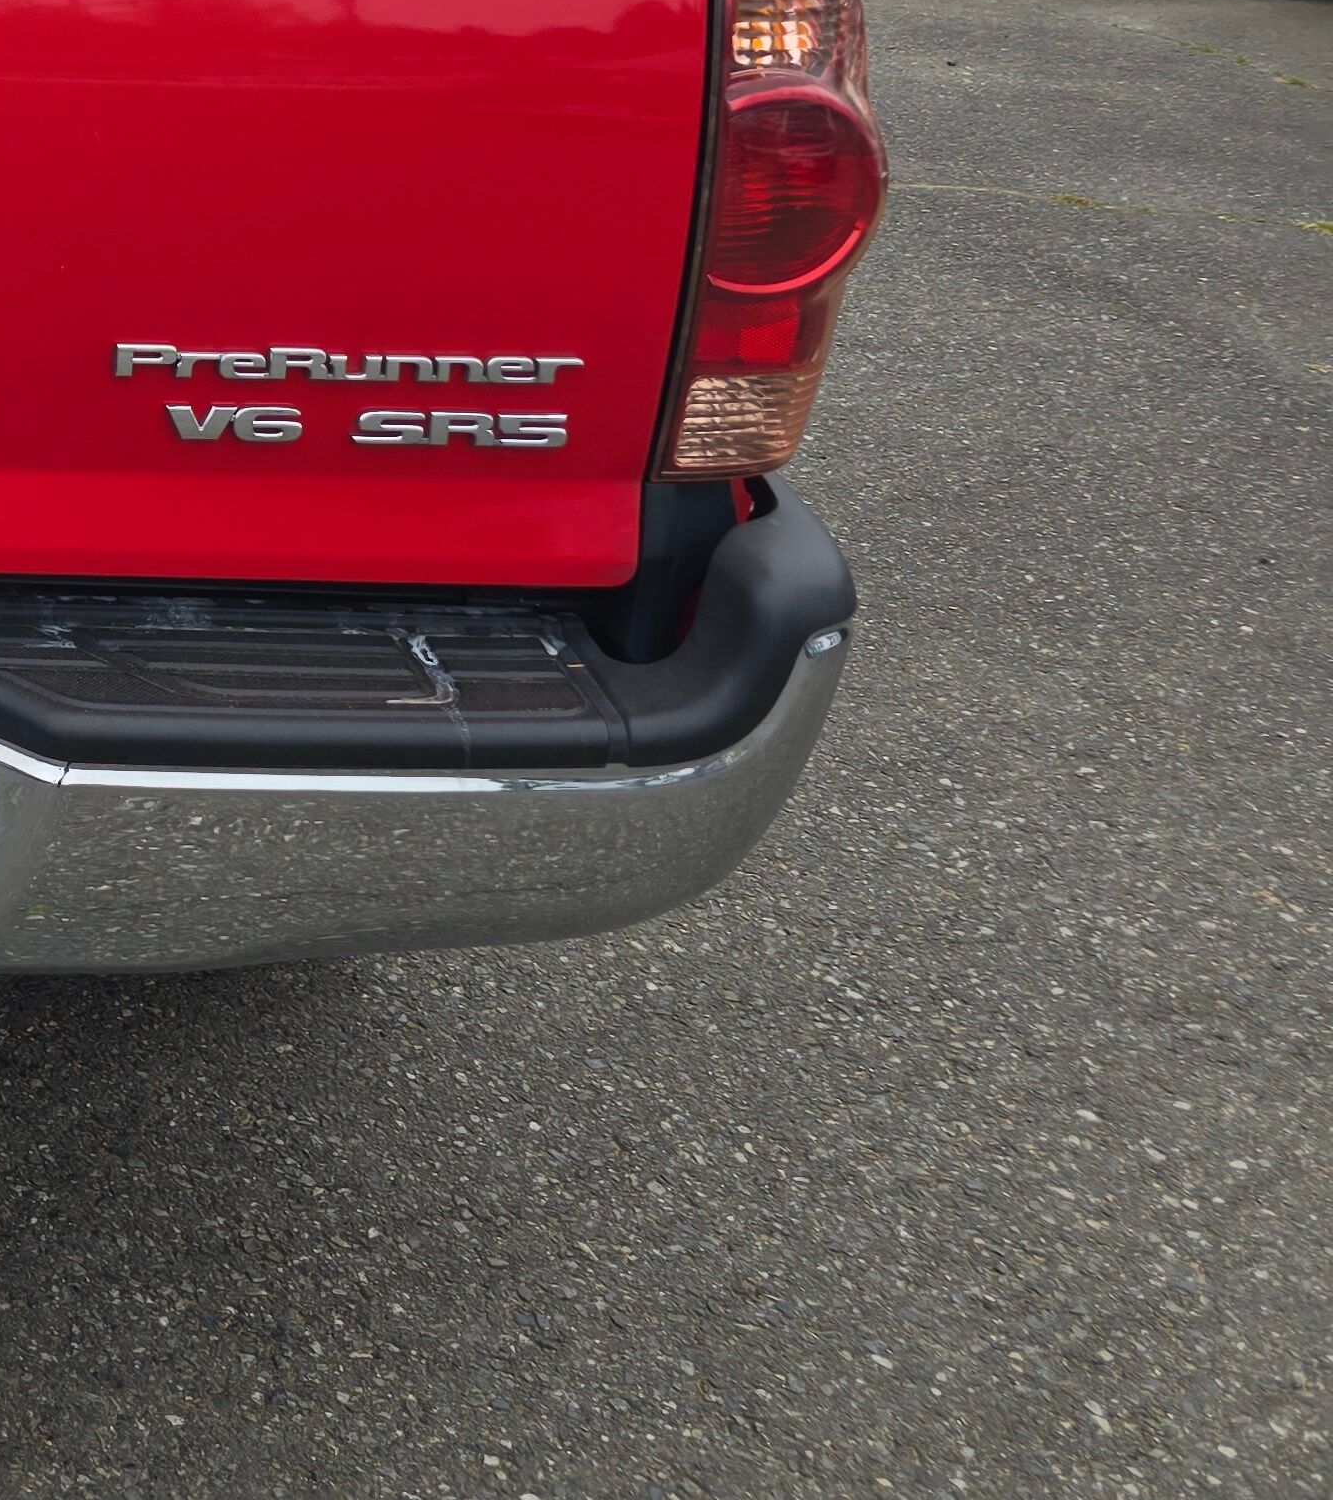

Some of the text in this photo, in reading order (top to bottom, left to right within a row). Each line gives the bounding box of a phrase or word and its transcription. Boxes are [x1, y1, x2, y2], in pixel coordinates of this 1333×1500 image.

[115, 343, 584, 383] PreRunner
[165, 405, 568, 447] V6 SR5
